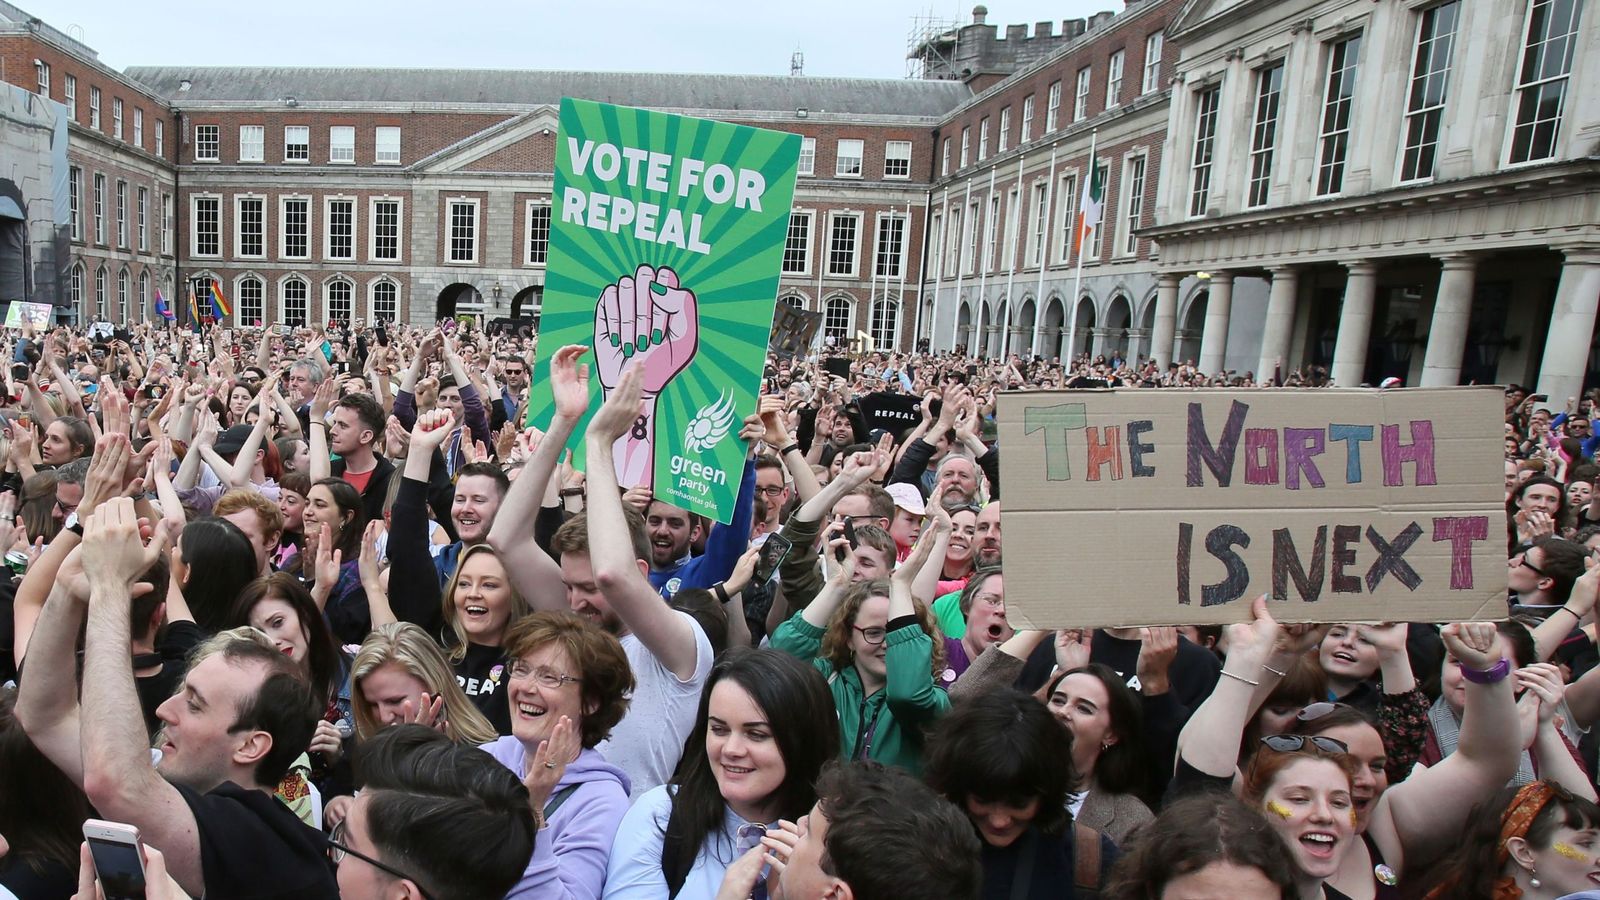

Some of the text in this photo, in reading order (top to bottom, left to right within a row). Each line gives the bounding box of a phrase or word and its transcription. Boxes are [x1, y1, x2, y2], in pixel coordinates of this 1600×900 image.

[567, 136, 766, 213] VOTE FOR
[561, 186, 711, 255] REPEAL
[874, 409, 916, 421] REPEAL
[670, 454, 727, 486] green
[678, 476, 710, 496] party
[666, 487, 718, 510] comhaontas glas
[1177, 515, 1489, 607] IS NEXT
